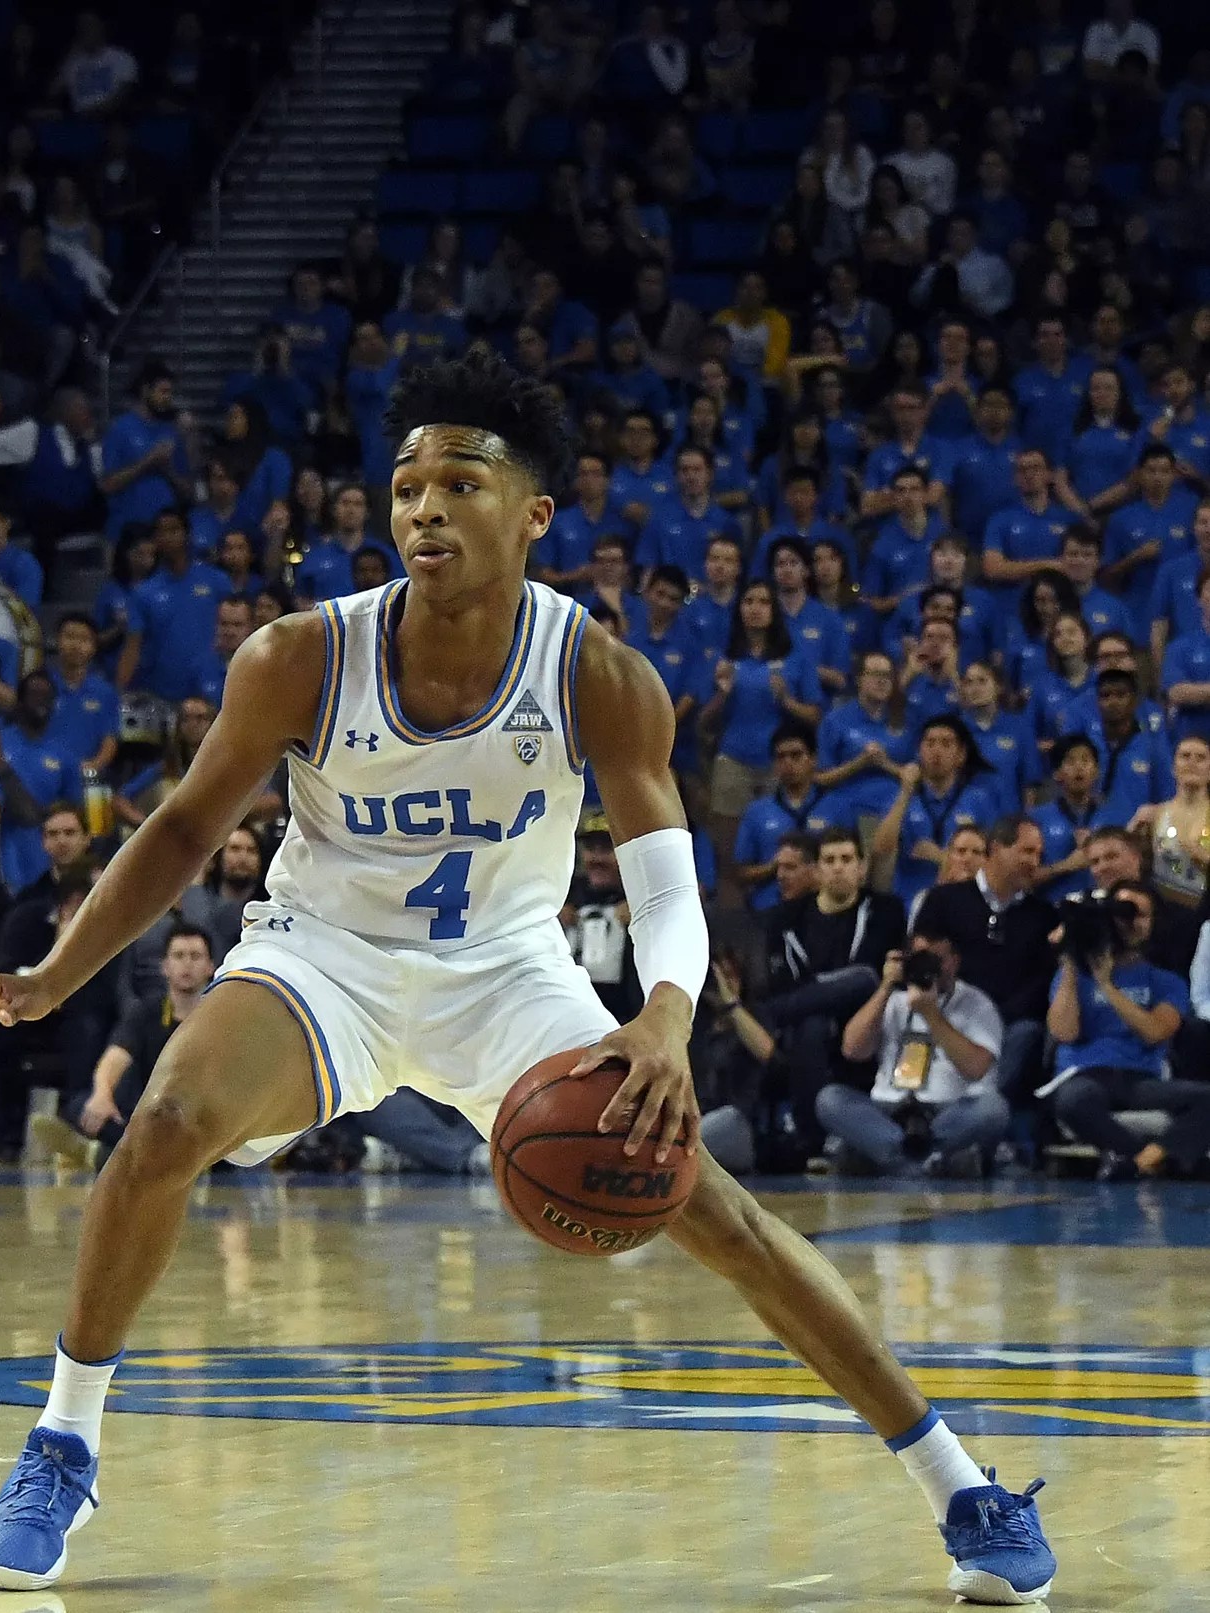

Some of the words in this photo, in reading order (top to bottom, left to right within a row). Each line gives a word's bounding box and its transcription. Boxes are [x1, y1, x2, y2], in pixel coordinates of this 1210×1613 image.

[510, 714, 543, 726] JRW
[521, 748, 535, 761] 12
[338, 788, 546, 842] UCLA
[404, 850, 474, 941] 4
